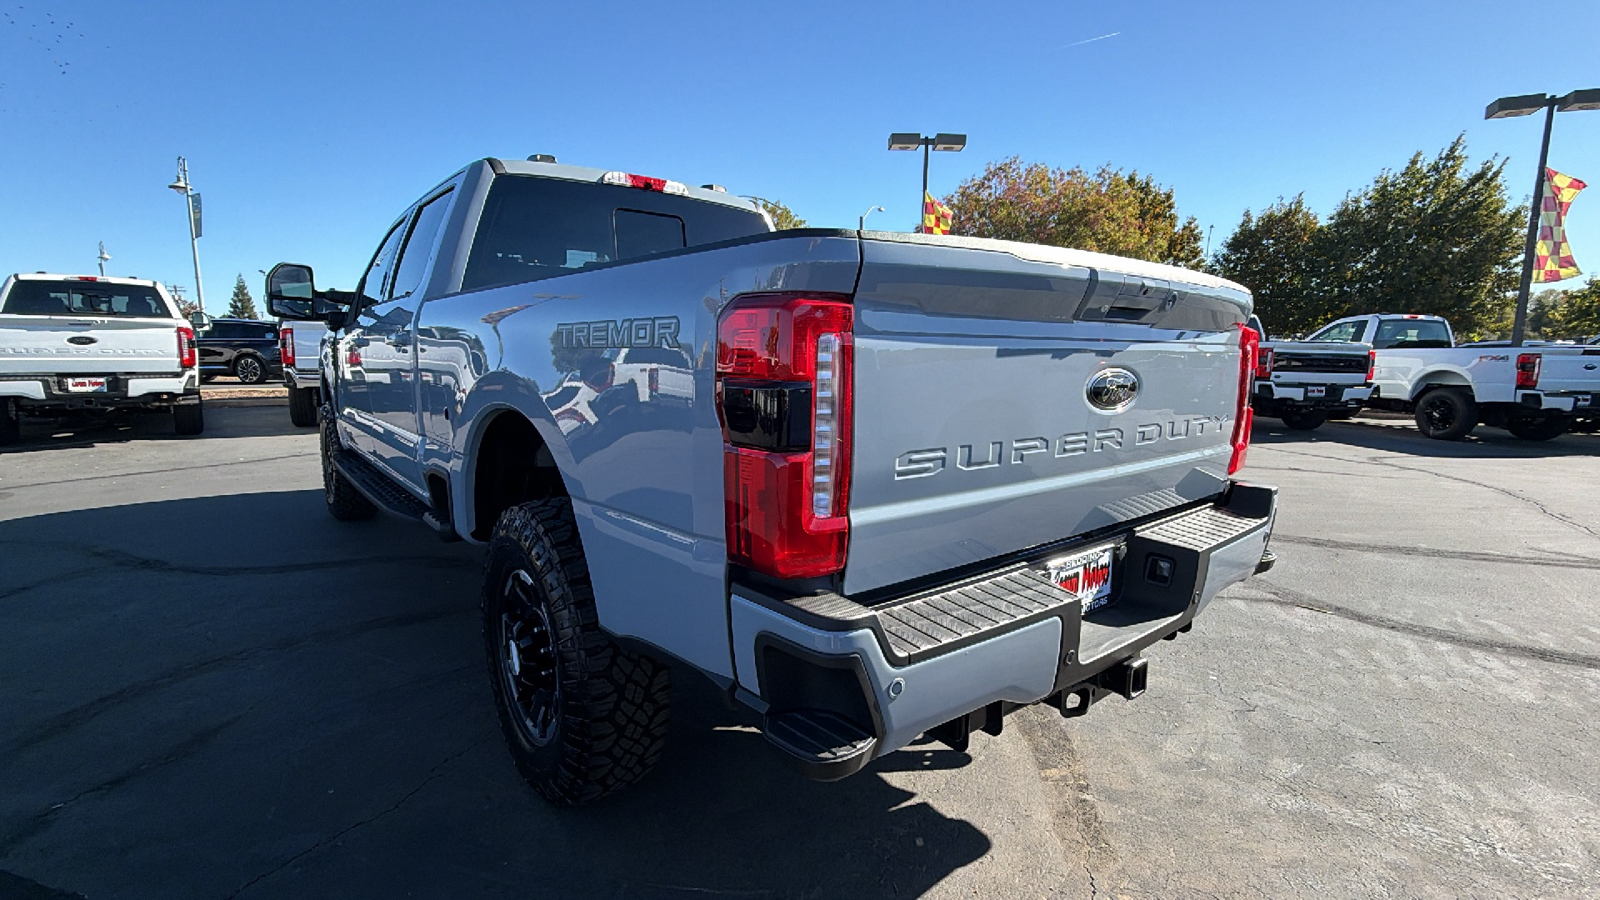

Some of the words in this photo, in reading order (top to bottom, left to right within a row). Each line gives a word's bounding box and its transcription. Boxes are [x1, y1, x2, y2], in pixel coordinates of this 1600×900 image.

[557, 315, 681, 348] TREMOR
[0, 347, 91, 355] UPER
[894, 428, 1123, 481] SUPER
[1135, 414, 1230, 446] DUTY
